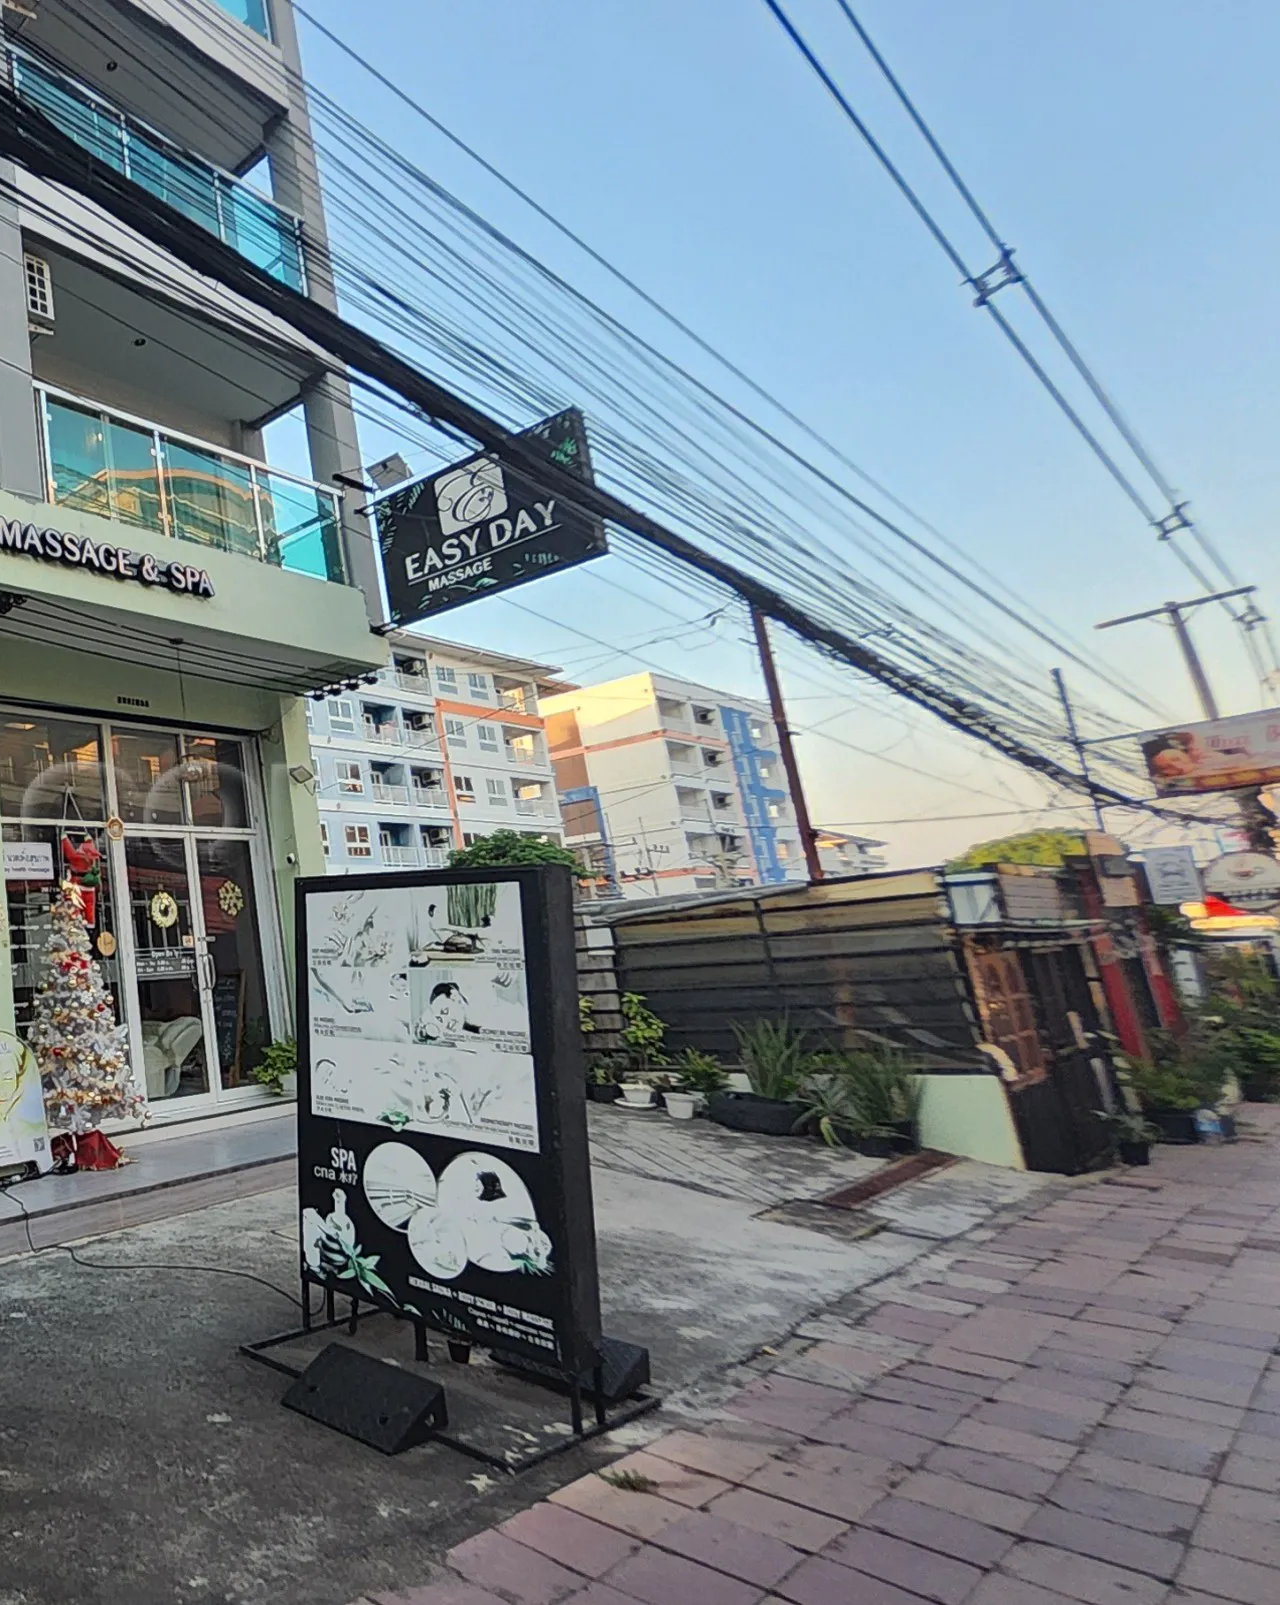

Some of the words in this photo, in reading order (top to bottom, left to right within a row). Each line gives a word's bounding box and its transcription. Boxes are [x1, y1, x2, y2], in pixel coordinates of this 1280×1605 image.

[404, 528, 481, 581] EASY
[488, 500, 557, 548] DAY
[141, 554, 161, 583] &
[170, 561, 216, 598] SPA
[428, 557, 493, 592] MASSAGE
[330, 1146, 357, 1172] SPA
